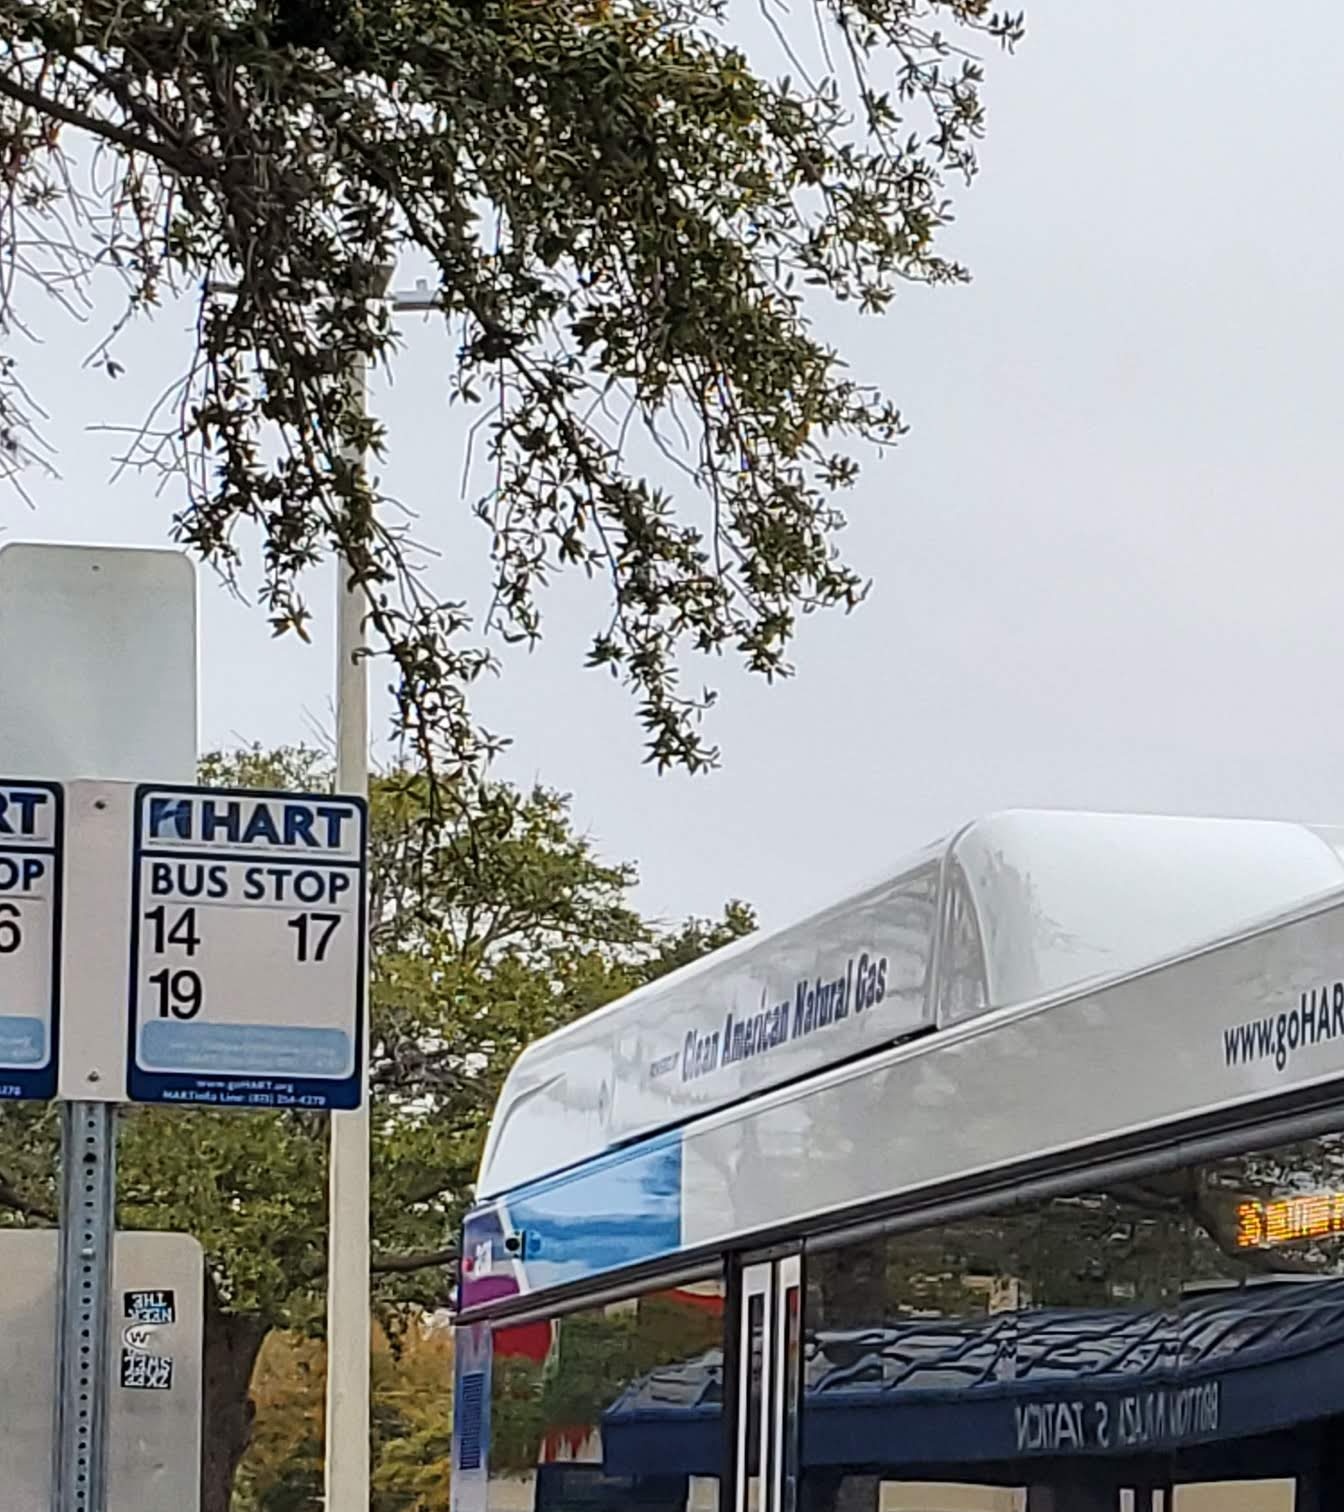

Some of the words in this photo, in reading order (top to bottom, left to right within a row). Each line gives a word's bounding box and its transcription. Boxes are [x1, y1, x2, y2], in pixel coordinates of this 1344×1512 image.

[202, 799, 353, 848] HART
[151, 862, 229, 898] BUS
[243, 867, 350, 904] STOP
[144, 905, 201, 957] 14
[287, 912, 342, 962] 17
[149, 968, 203, 1020] 19
[720, 988, 790, 1067] American
[791, 958, 854, 1040] Natural
[854, 952, 888, 1014] Gas
